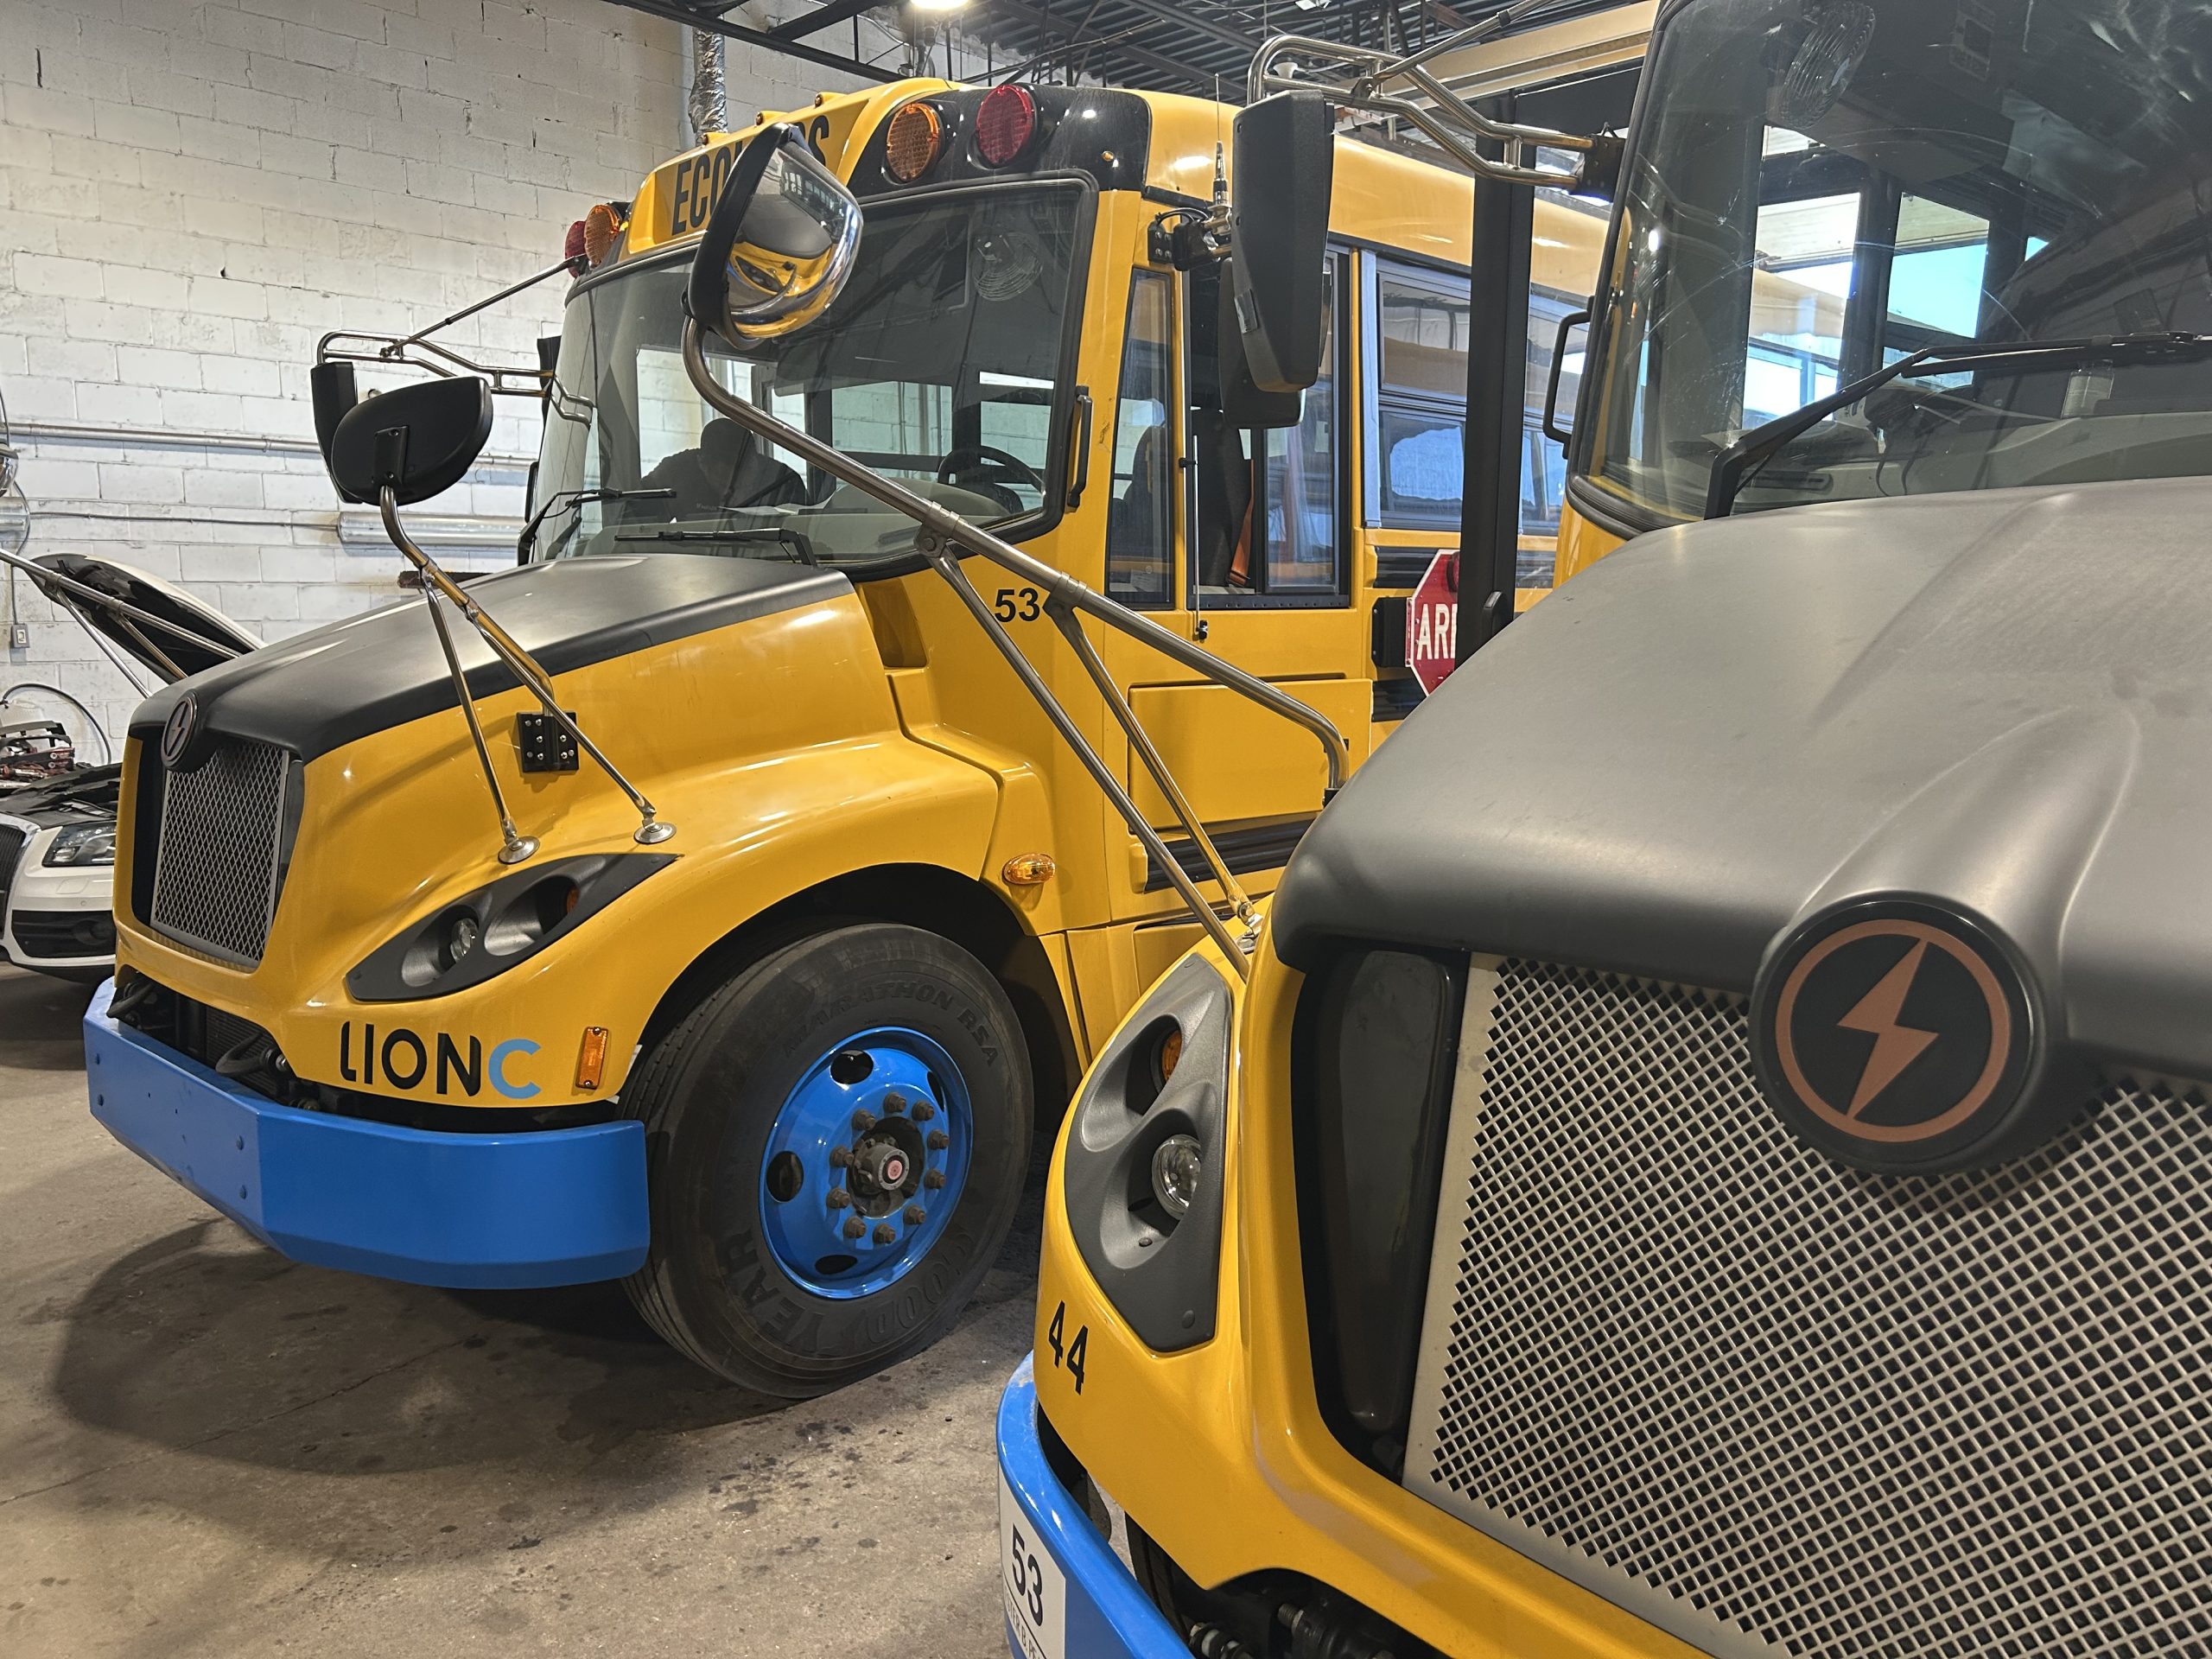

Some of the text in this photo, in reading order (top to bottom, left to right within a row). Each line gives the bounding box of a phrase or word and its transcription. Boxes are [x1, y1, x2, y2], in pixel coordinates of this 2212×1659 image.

[995, 588, 1040, 622] 53
[783, 981, 999, 1068] MARATHON RSA
[1048, 1300, 1089, 1395] 44
[1012, 1522, 1043, 1627] 53
